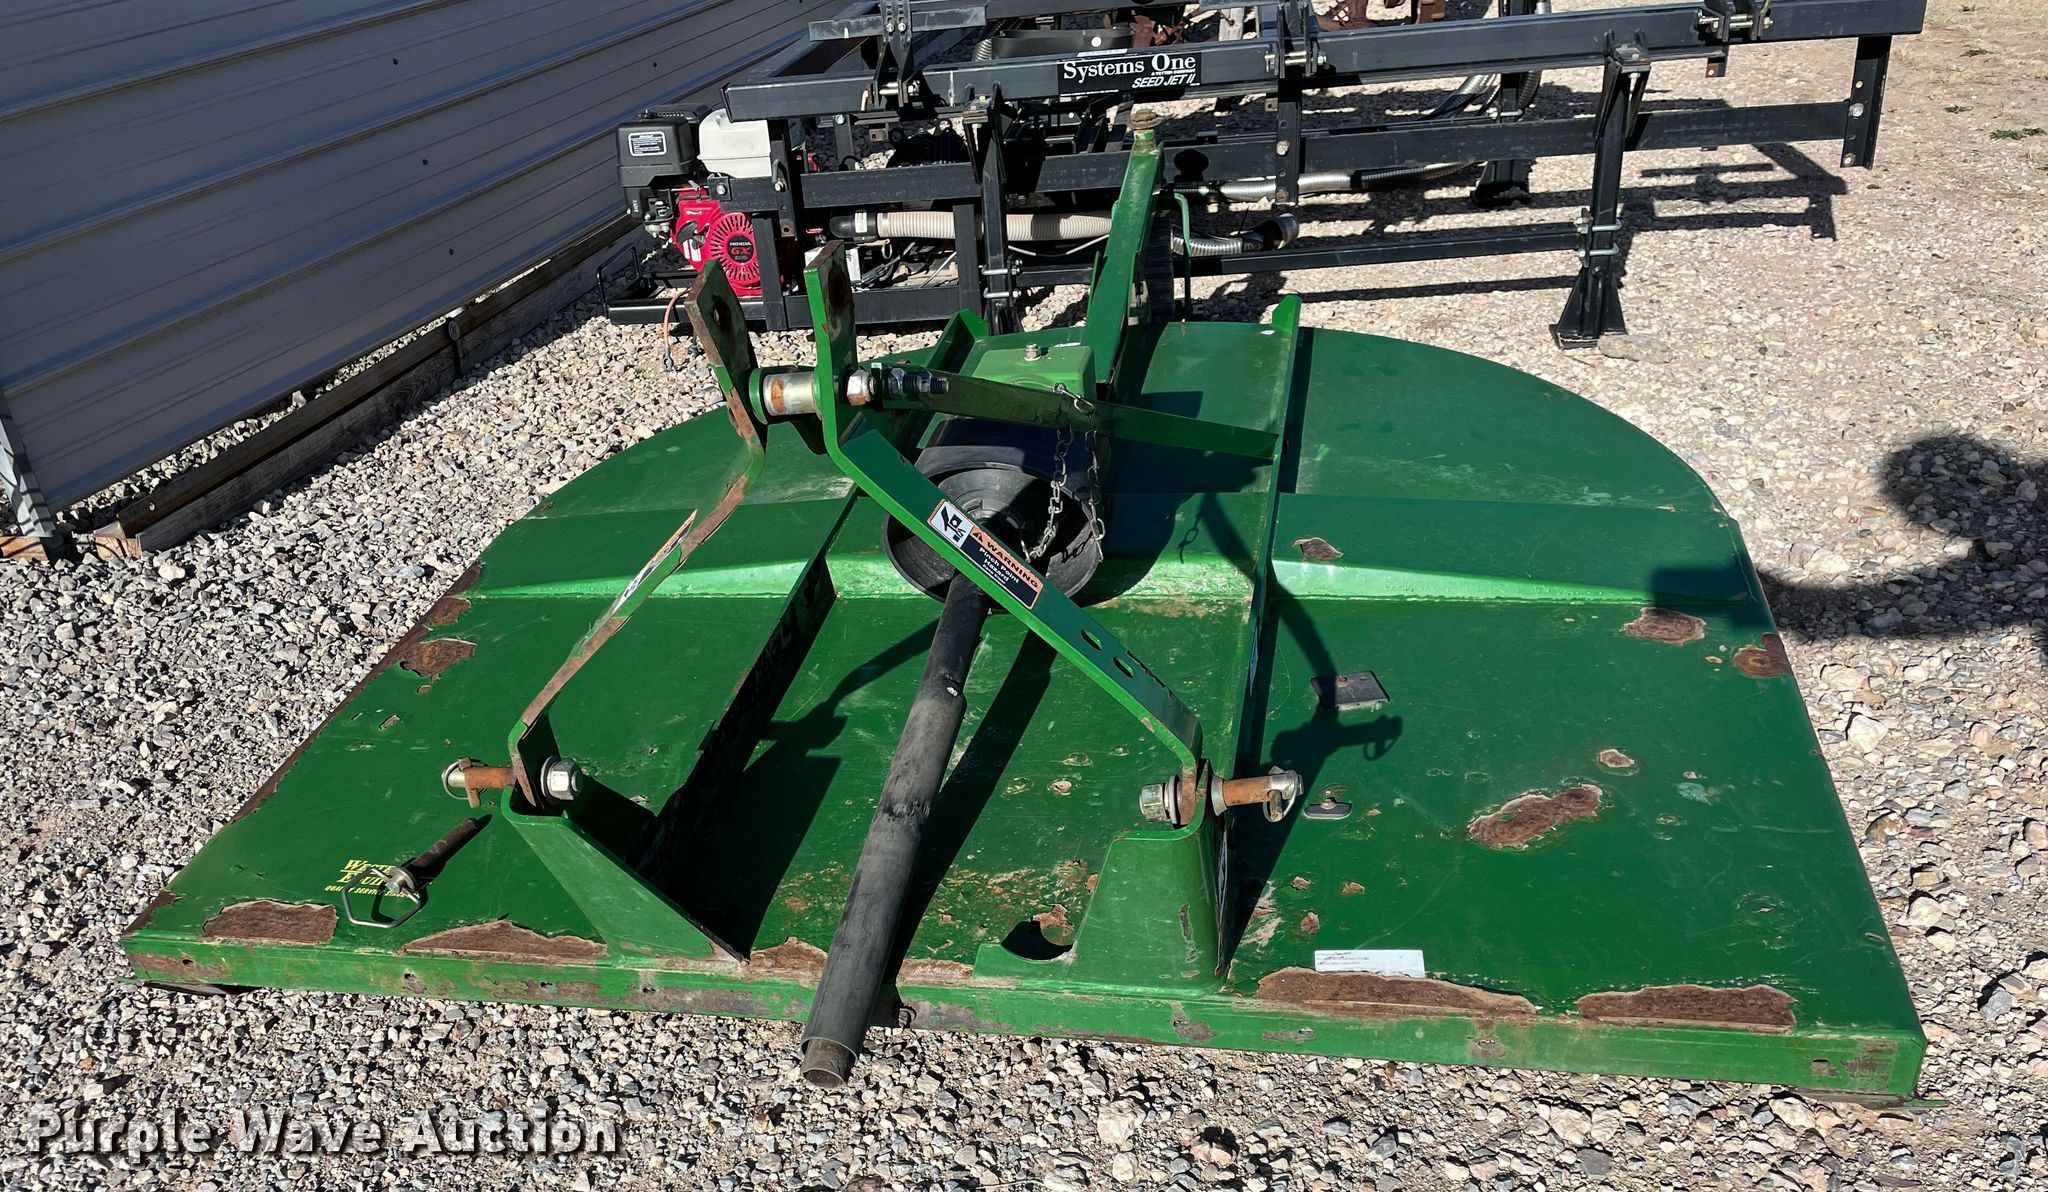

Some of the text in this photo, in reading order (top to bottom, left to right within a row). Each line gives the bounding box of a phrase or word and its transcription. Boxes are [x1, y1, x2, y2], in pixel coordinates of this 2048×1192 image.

[1063, 53, 1196, 83] Systems One
[1132, 75, 1164, 88] SEED
[1163, 73, 1189, 86] JET
[731, 247, 751, 255] GX
[979, 547, 1020, 584] Pinch Point
[984, 558, 1010, 582] Hazard
[987, 541, 1038, 588] WARNING
